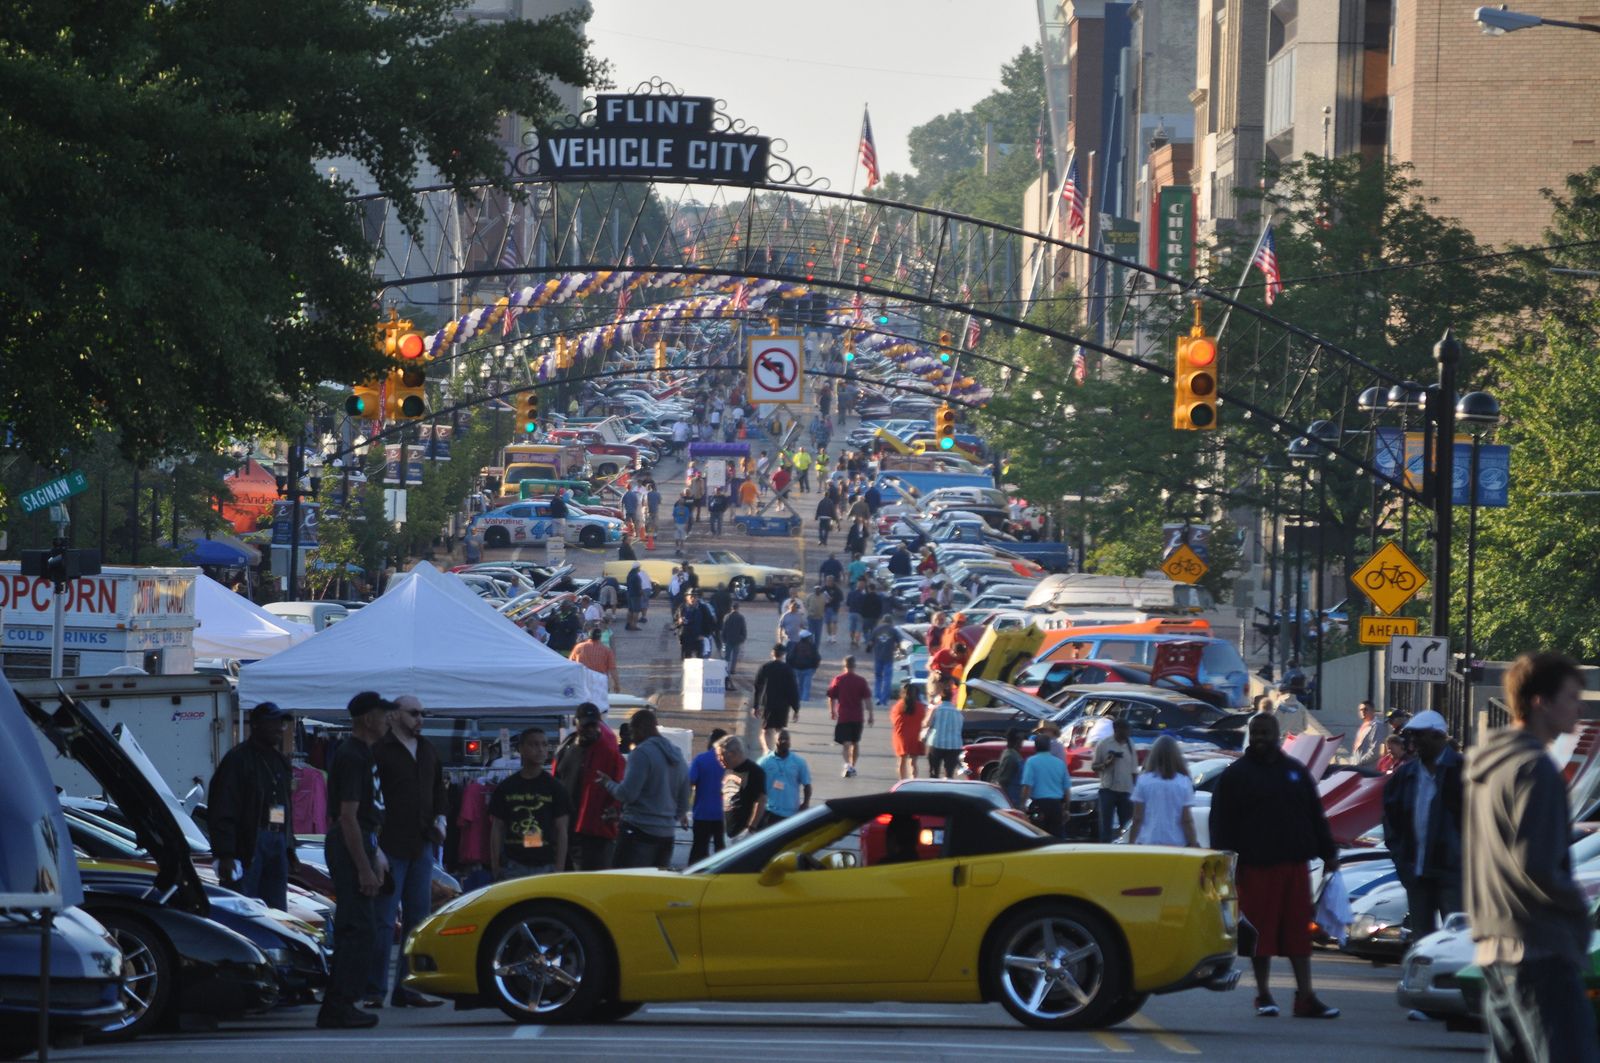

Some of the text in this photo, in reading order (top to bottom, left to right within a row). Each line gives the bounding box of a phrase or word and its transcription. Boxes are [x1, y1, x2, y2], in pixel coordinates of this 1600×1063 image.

[606, 99, 700, 124] FLINT
[548, 138, 758, 173] VEHICLE CITY
[22, 474, 84, 512] SAGINAW ST
[8, 629, 108, 644] COLD RINKS
[1368, 624, 1409, 637] AHEAD
[1392, 665, 1445, 676] ONLY ONLY
